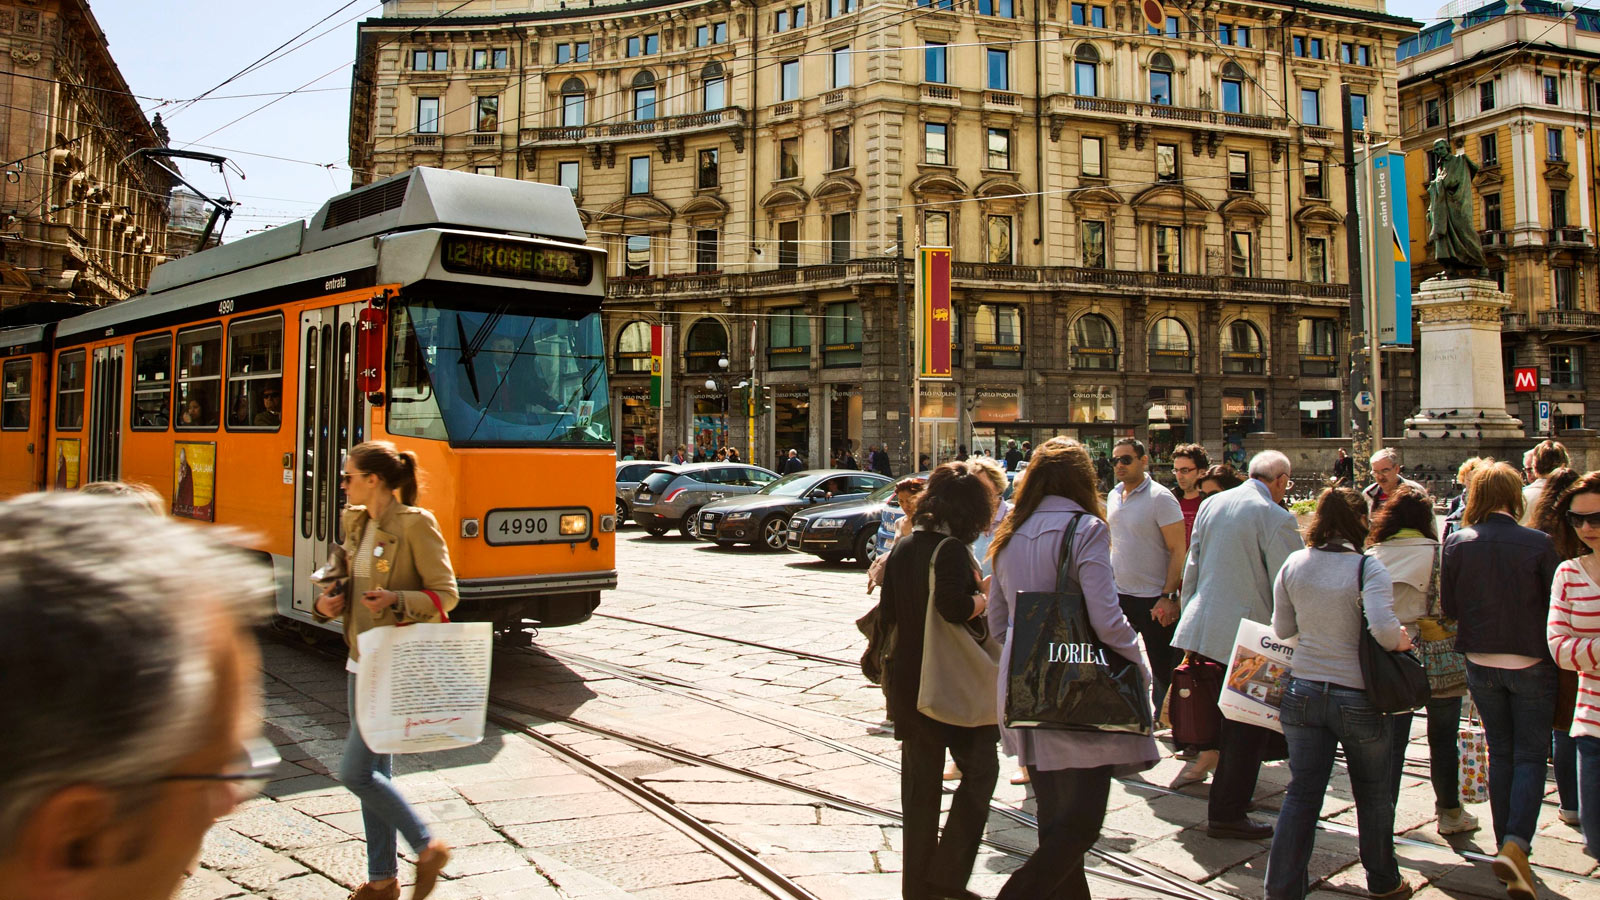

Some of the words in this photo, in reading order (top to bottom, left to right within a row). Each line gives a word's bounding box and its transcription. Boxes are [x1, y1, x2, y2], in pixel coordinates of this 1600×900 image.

[1377, 173, 1387, 198] lucia
[1380, 201, 1388, 227] saint
[483, 246, 568, 272] ROSERIO
[325, 276, 347, 290] entrata
[218, 300, 235, 314] 4990
[1515, 372, 1536, 387] M
[499, 517, 548, 535] 4990
